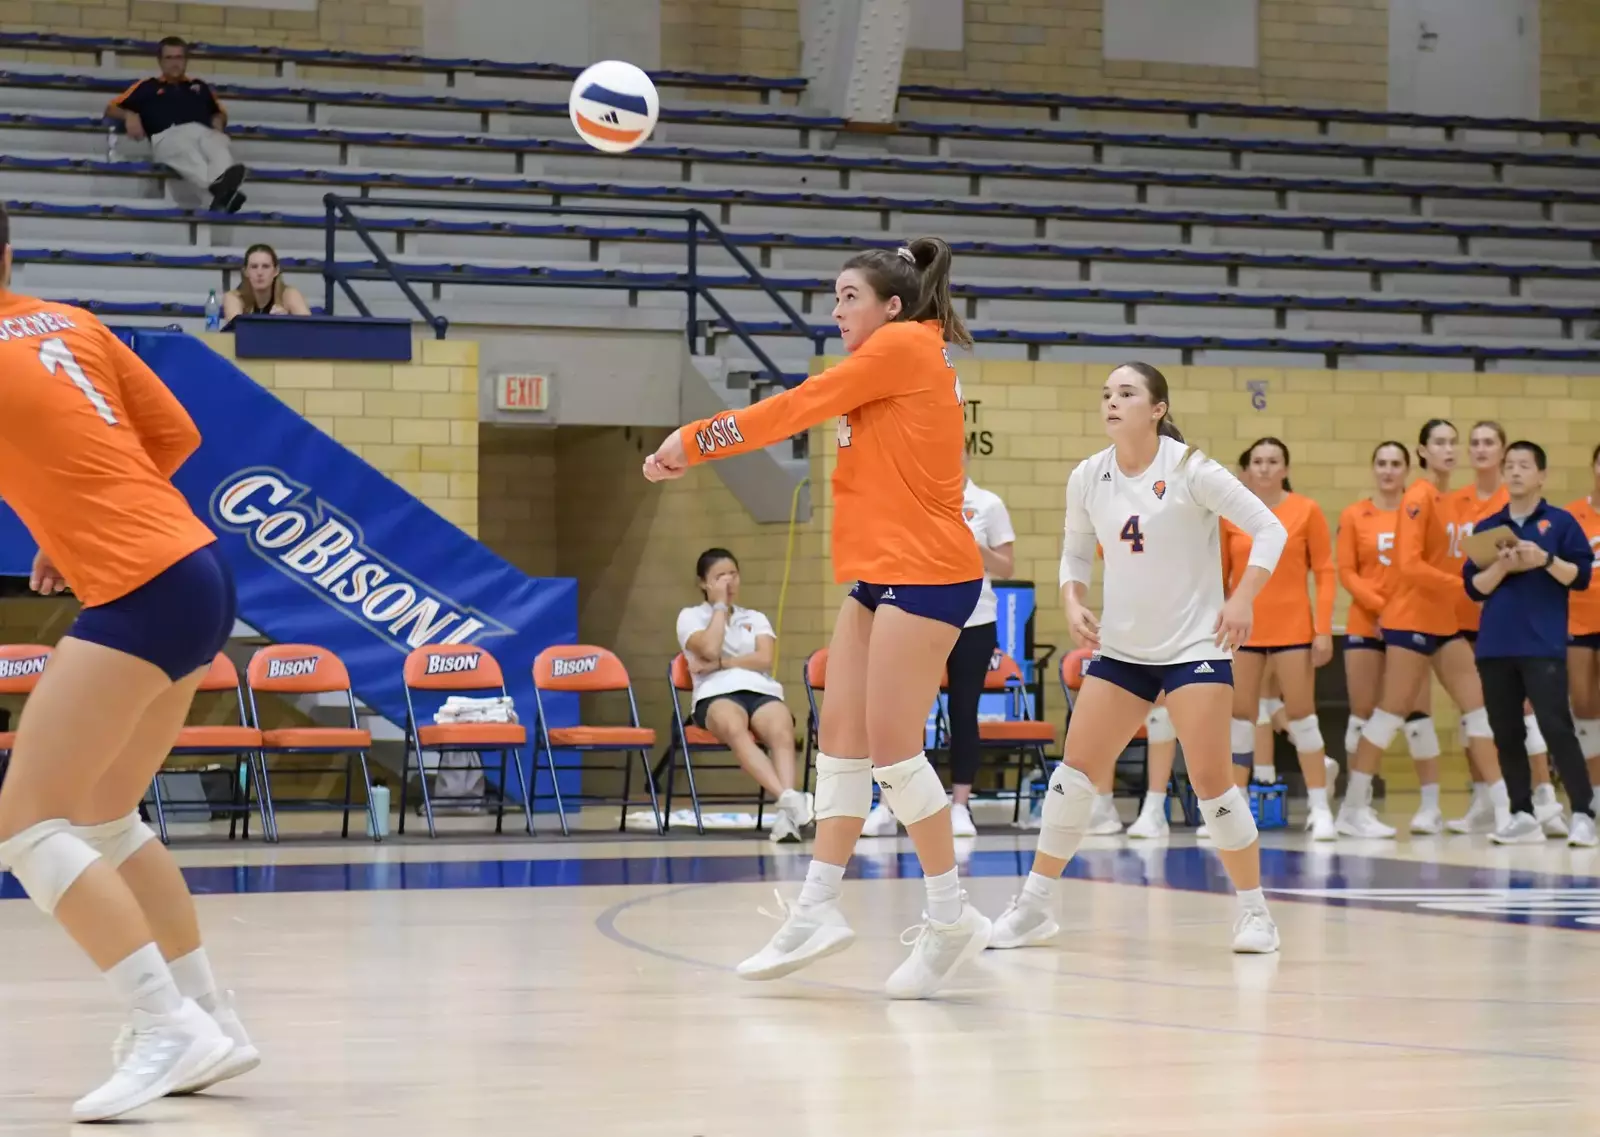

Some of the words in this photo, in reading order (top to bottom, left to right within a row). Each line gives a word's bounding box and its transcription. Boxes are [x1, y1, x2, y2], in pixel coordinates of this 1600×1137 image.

[38, 338, 119, 425] 1
[506, 376, 543, 406] EXIT
[1119, 515, 1144, 554] 4
[1377, 532, 1396, 567] 5
[0, 657, 46, 677] BISON
[269, 658, 317, 677] BISON
[428, 654, 479, 674] BISON
[553, 656, 597, 676] BISON
